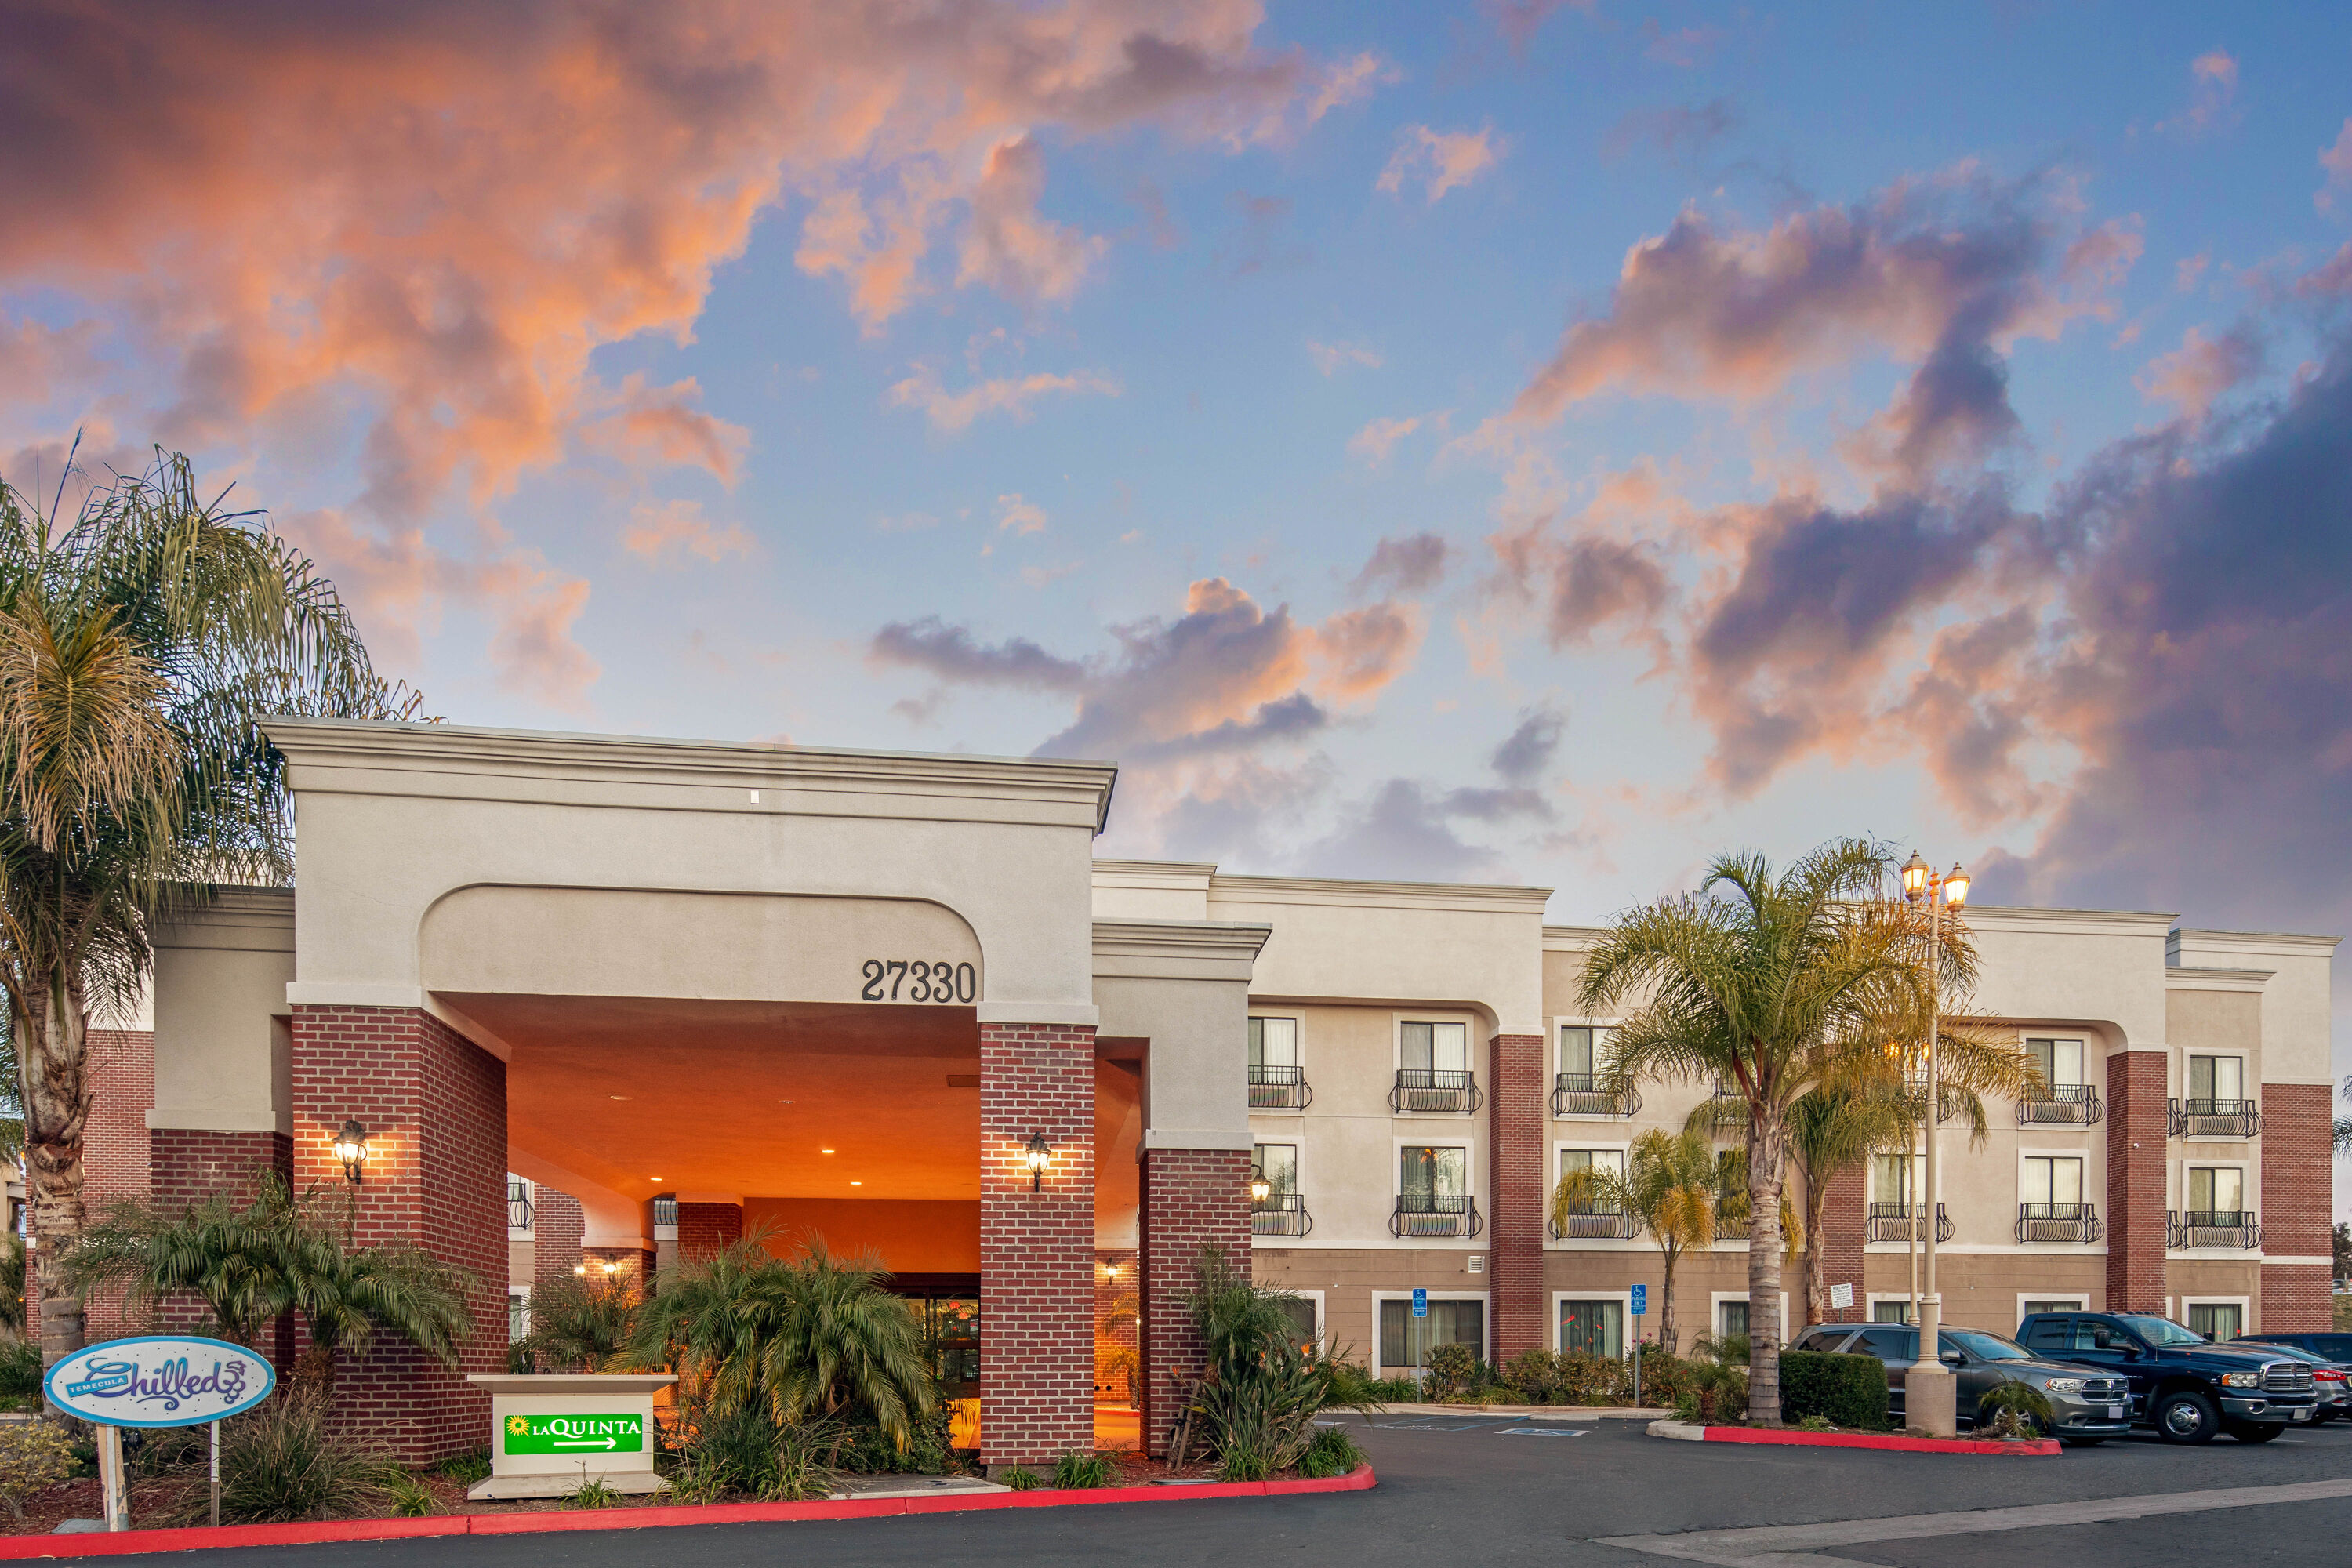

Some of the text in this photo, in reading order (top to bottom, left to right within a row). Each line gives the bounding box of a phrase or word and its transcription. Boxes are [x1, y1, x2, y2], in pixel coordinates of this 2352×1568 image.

[862, 959, 976, 1004] 27330
[68, 1377, 125, 1393] TEMECULA
[85, 1357, 223, 1399] Chilled
